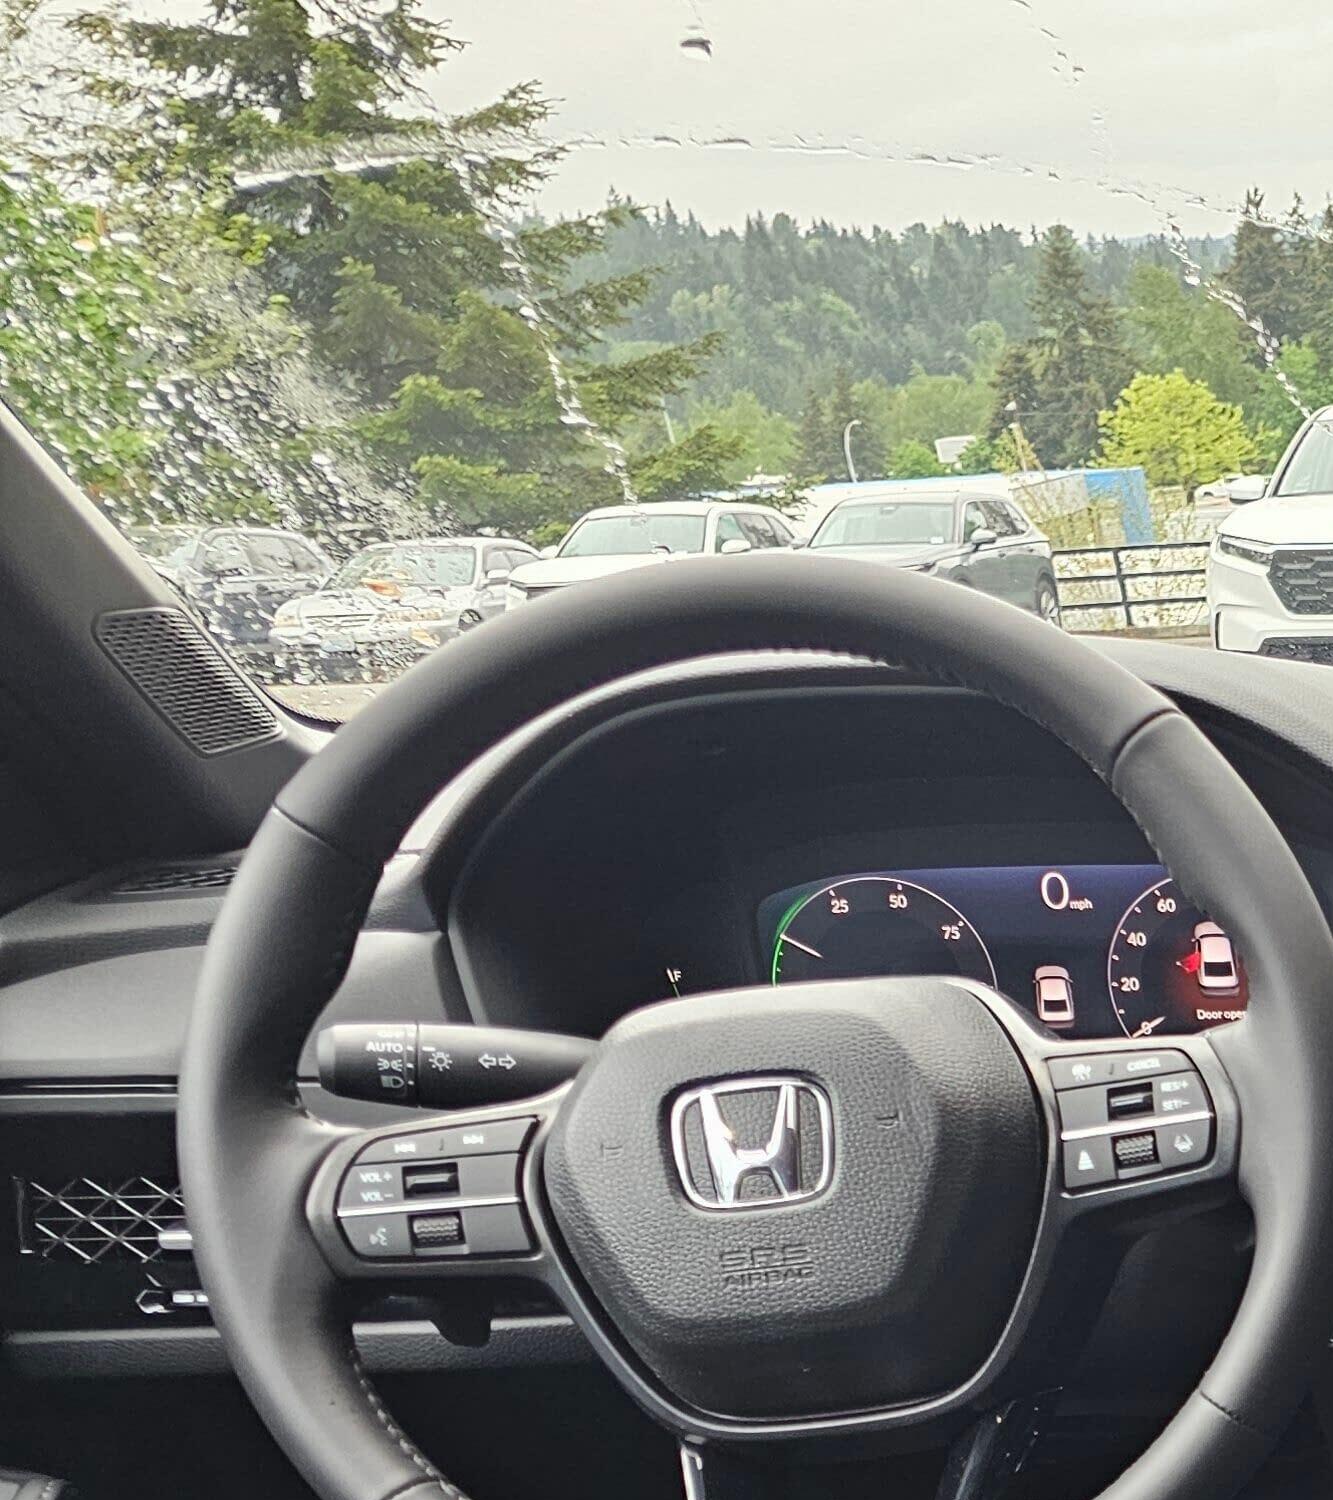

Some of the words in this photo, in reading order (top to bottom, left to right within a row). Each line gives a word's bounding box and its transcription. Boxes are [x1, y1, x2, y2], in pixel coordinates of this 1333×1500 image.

[1041, 871, 1069, 910] 0
[830, 899, 849, 914] 25
[888, 895, 908, 909] 50
[1069, 898, 1094, 911] mph
[1156, 898, 1177, 913] 60
[941, 925, 961, 940] 75
[1126, 932, 1147, 947] 40
[673, 970, 682, 982] F
[1120, 977, 1140, 991] 20
[1196, 1009, 1223, 1020] Door
[366, 1041, 403, 1053] AUTO
